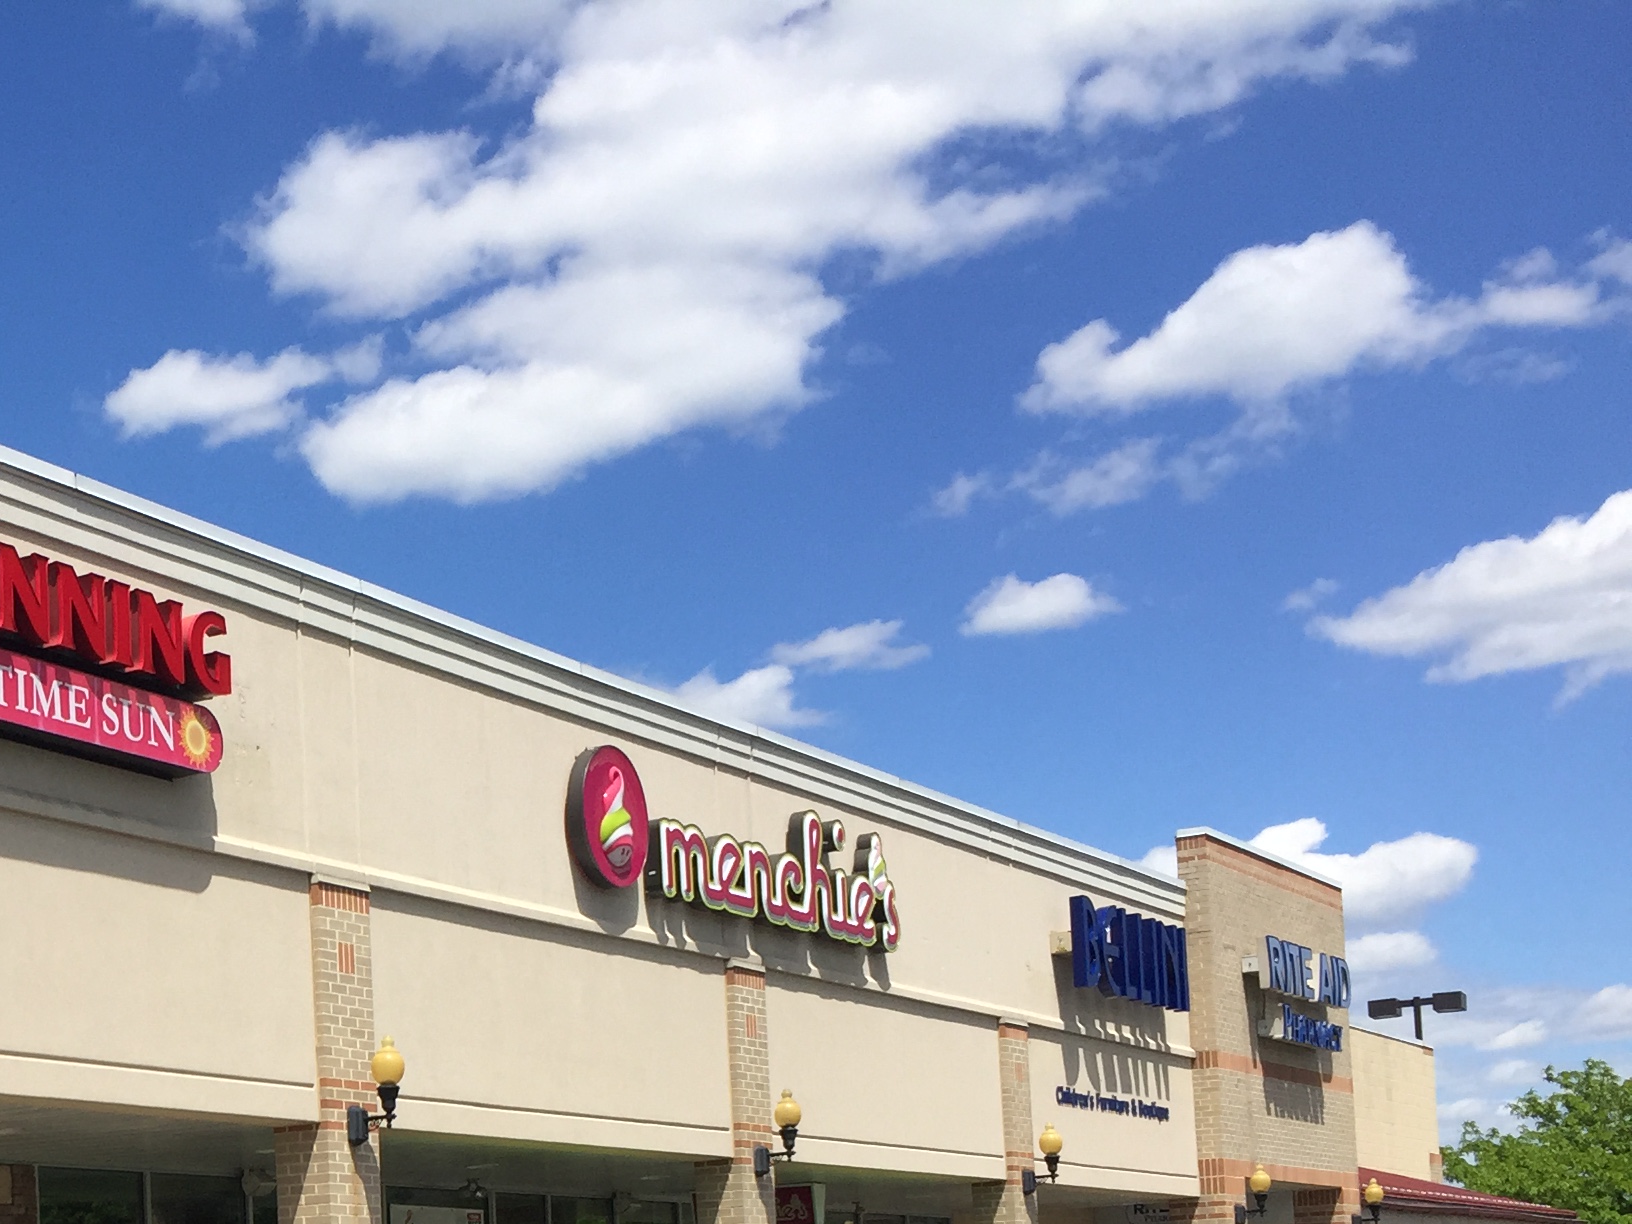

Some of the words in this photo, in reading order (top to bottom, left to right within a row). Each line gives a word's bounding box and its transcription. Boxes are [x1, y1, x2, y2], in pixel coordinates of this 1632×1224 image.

[102, 692, 176, 752] SUN
[1265, 935, 1316, 1000] RITE
[1318, 952, 1352, 1009] AID
